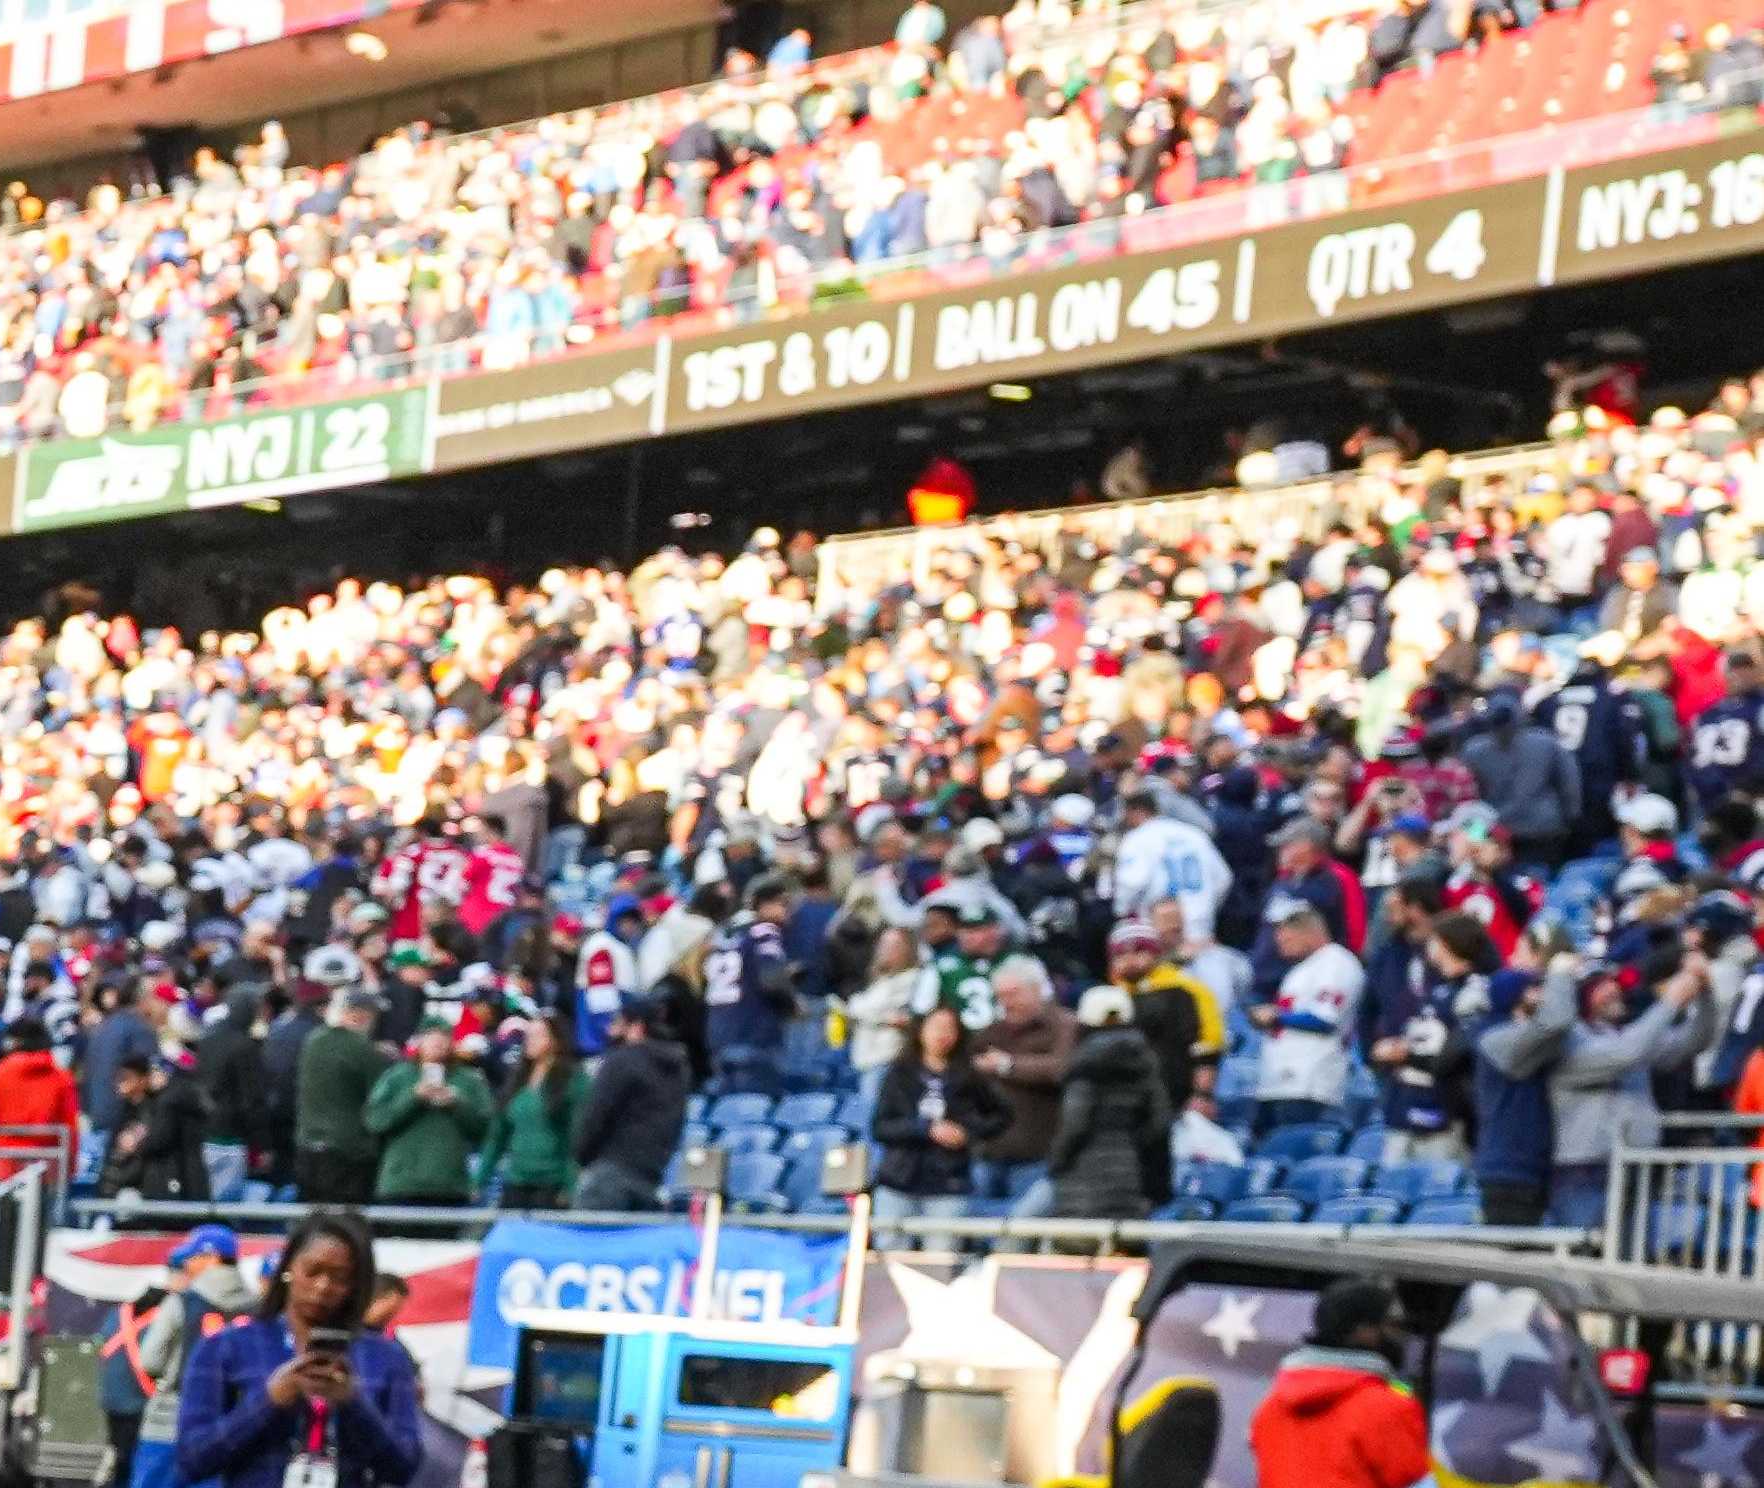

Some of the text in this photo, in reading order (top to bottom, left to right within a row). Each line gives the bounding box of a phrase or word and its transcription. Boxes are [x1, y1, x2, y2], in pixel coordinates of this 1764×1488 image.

[1578, 168, 1701, 254] NYJ:
[1308, 208, 1487, 318] QTR 4
[933, 259, 1222, 370] BALL ON 45
[683, 319, 892, 413] 1ST & 10
[188, 402, 389, 491] NYJ 22
[548, 1262, 663, 1316] CBS
